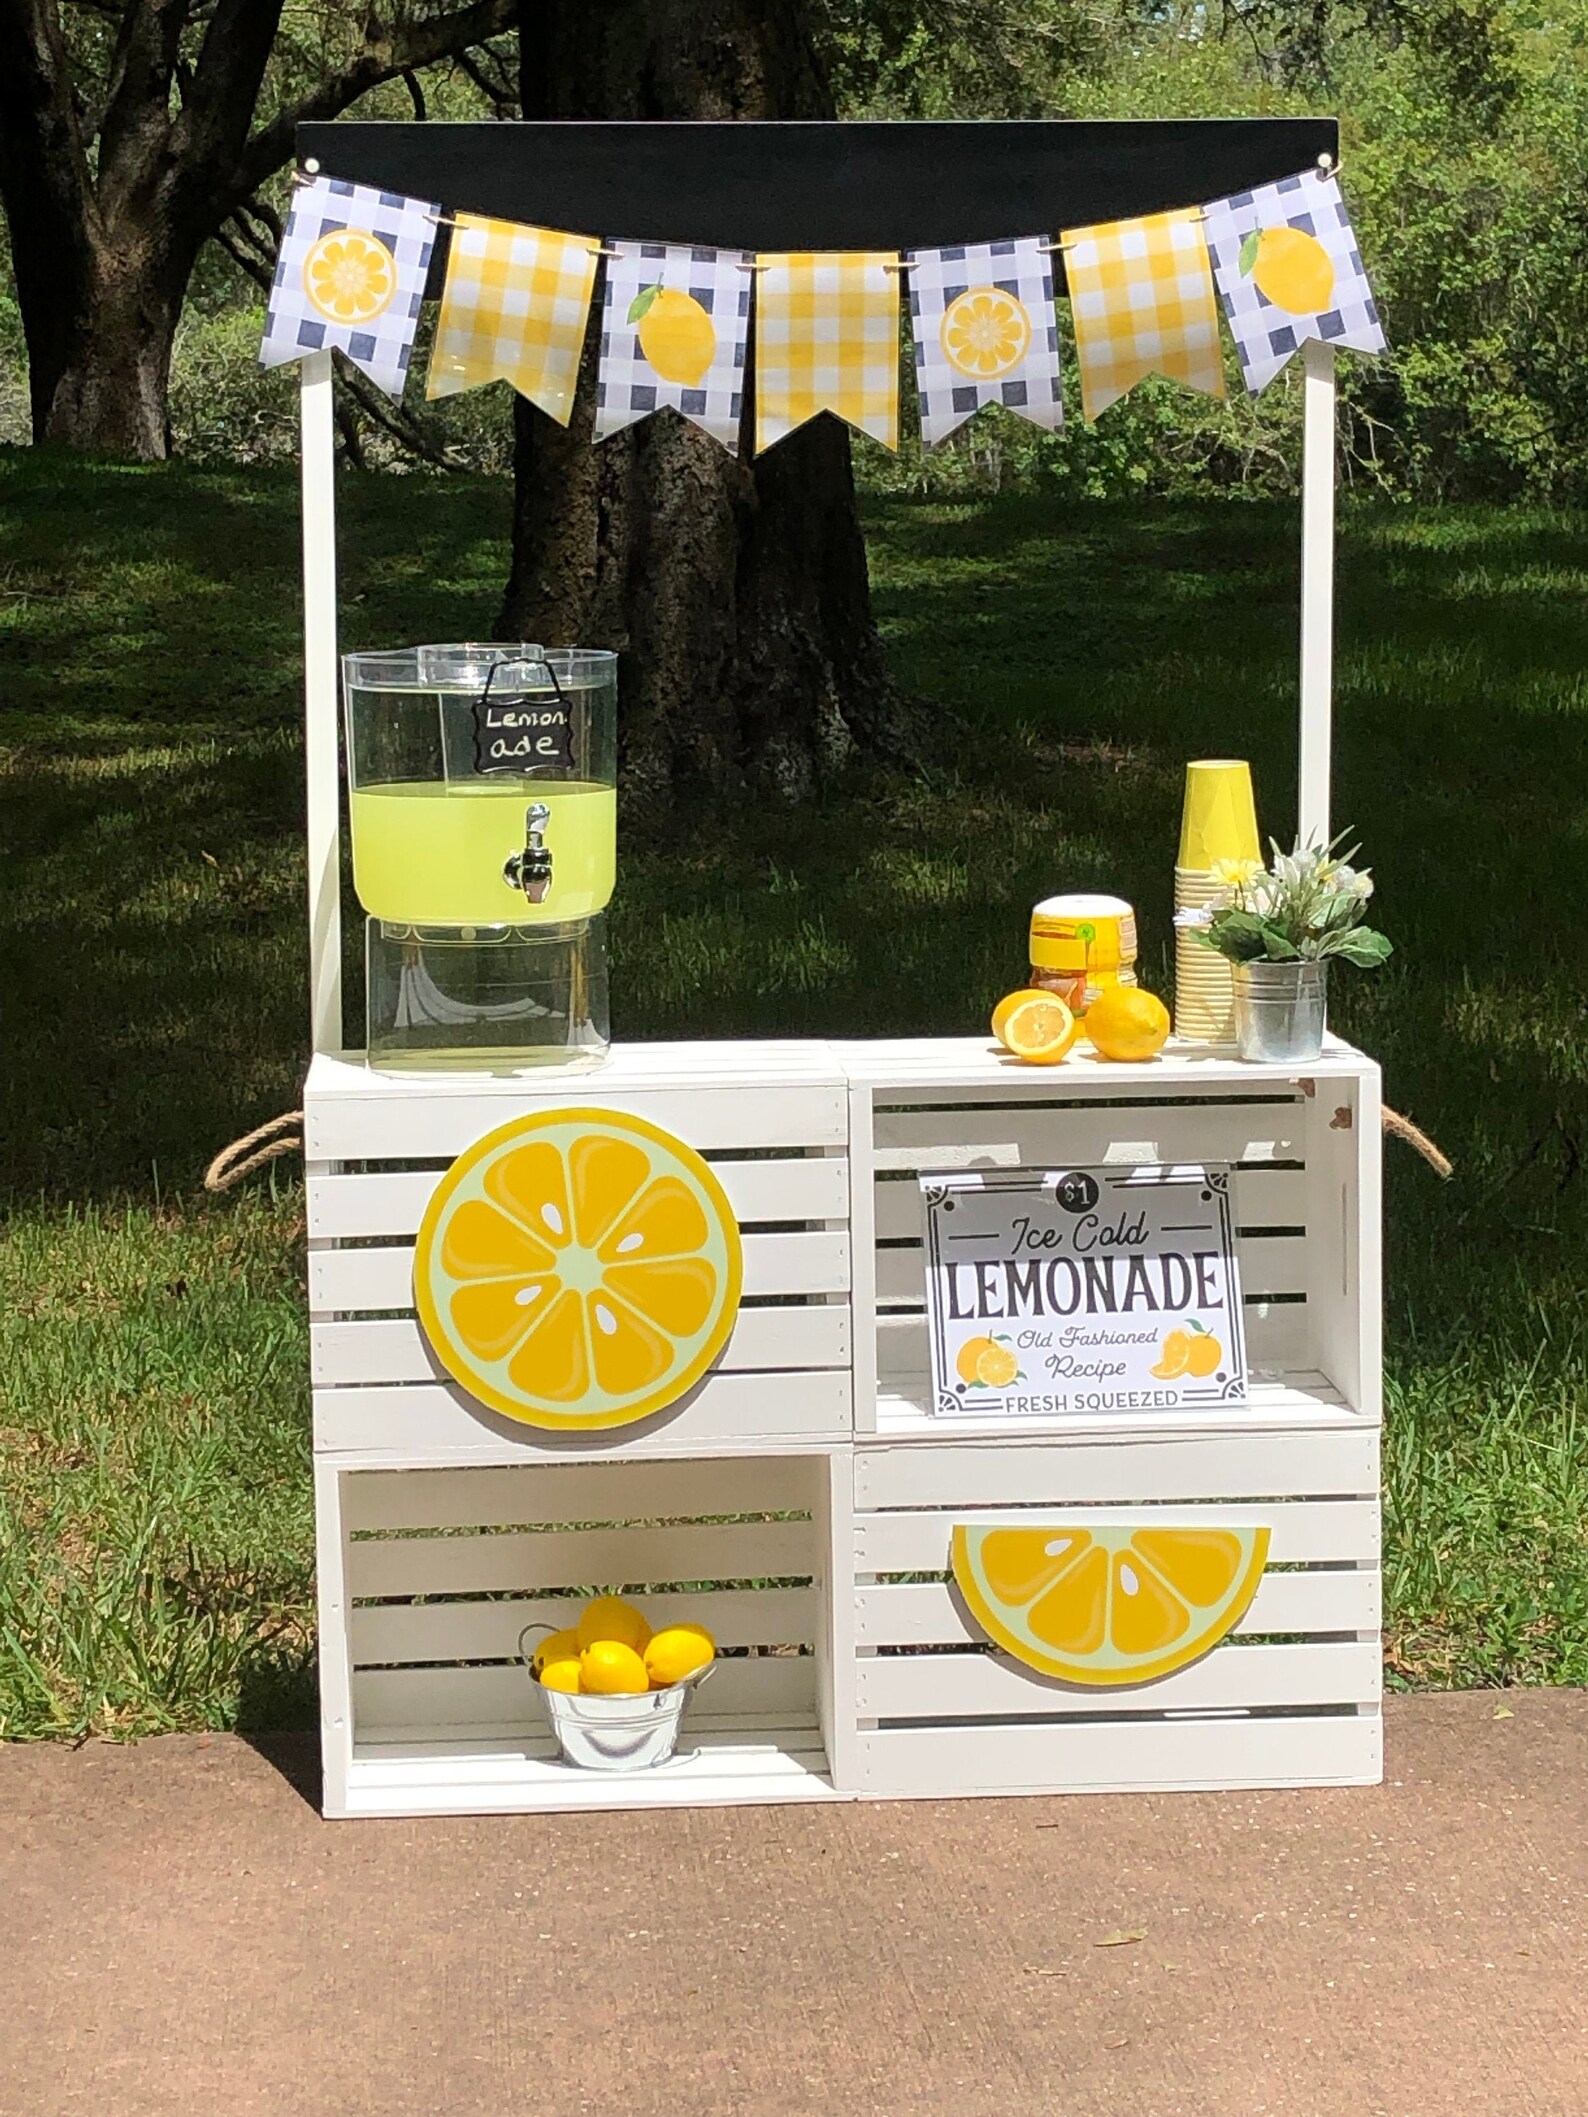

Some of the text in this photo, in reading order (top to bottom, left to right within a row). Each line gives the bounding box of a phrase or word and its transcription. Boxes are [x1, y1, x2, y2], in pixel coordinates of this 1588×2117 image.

[489, 735, 560, 758] ade
[1064, 1181, 1089, 1205] $1
[1011, 1211, 1149, 1254] Ice Cold
[945, 1251, 1223, 1319] LEMONADE
[1017, 1327, 1158, 1348] Old Fashioned
[1045, 1354, 1126, 1382] Recipe
[1005, 1390, 1178, 1413] FRESH SQUEEZED
